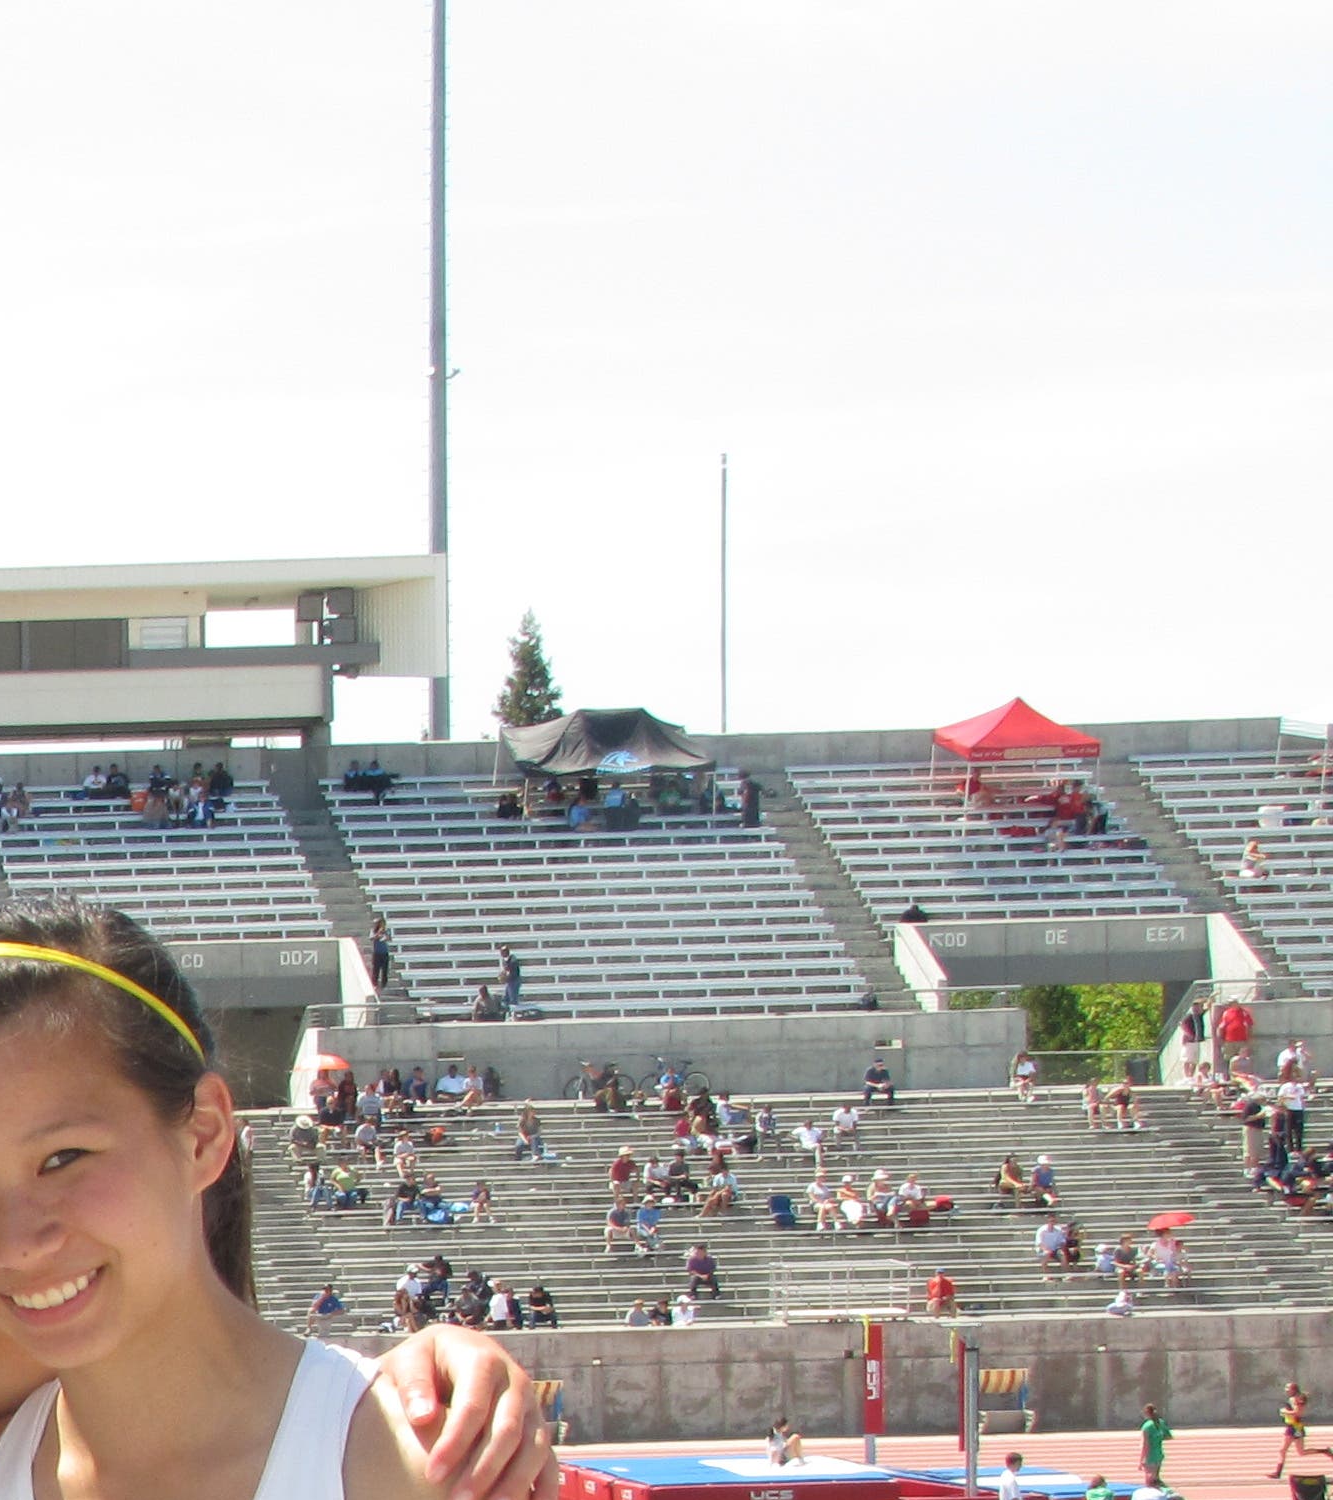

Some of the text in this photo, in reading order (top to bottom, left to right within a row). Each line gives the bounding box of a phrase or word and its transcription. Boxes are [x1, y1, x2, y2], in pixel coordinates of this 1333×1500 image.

[1045, 929, 1069, 945] DE
[1145, 926, 1169, 942] EE
[181, 952, 204, 968] CD
[749, 1489, 794, 1500] UCS
